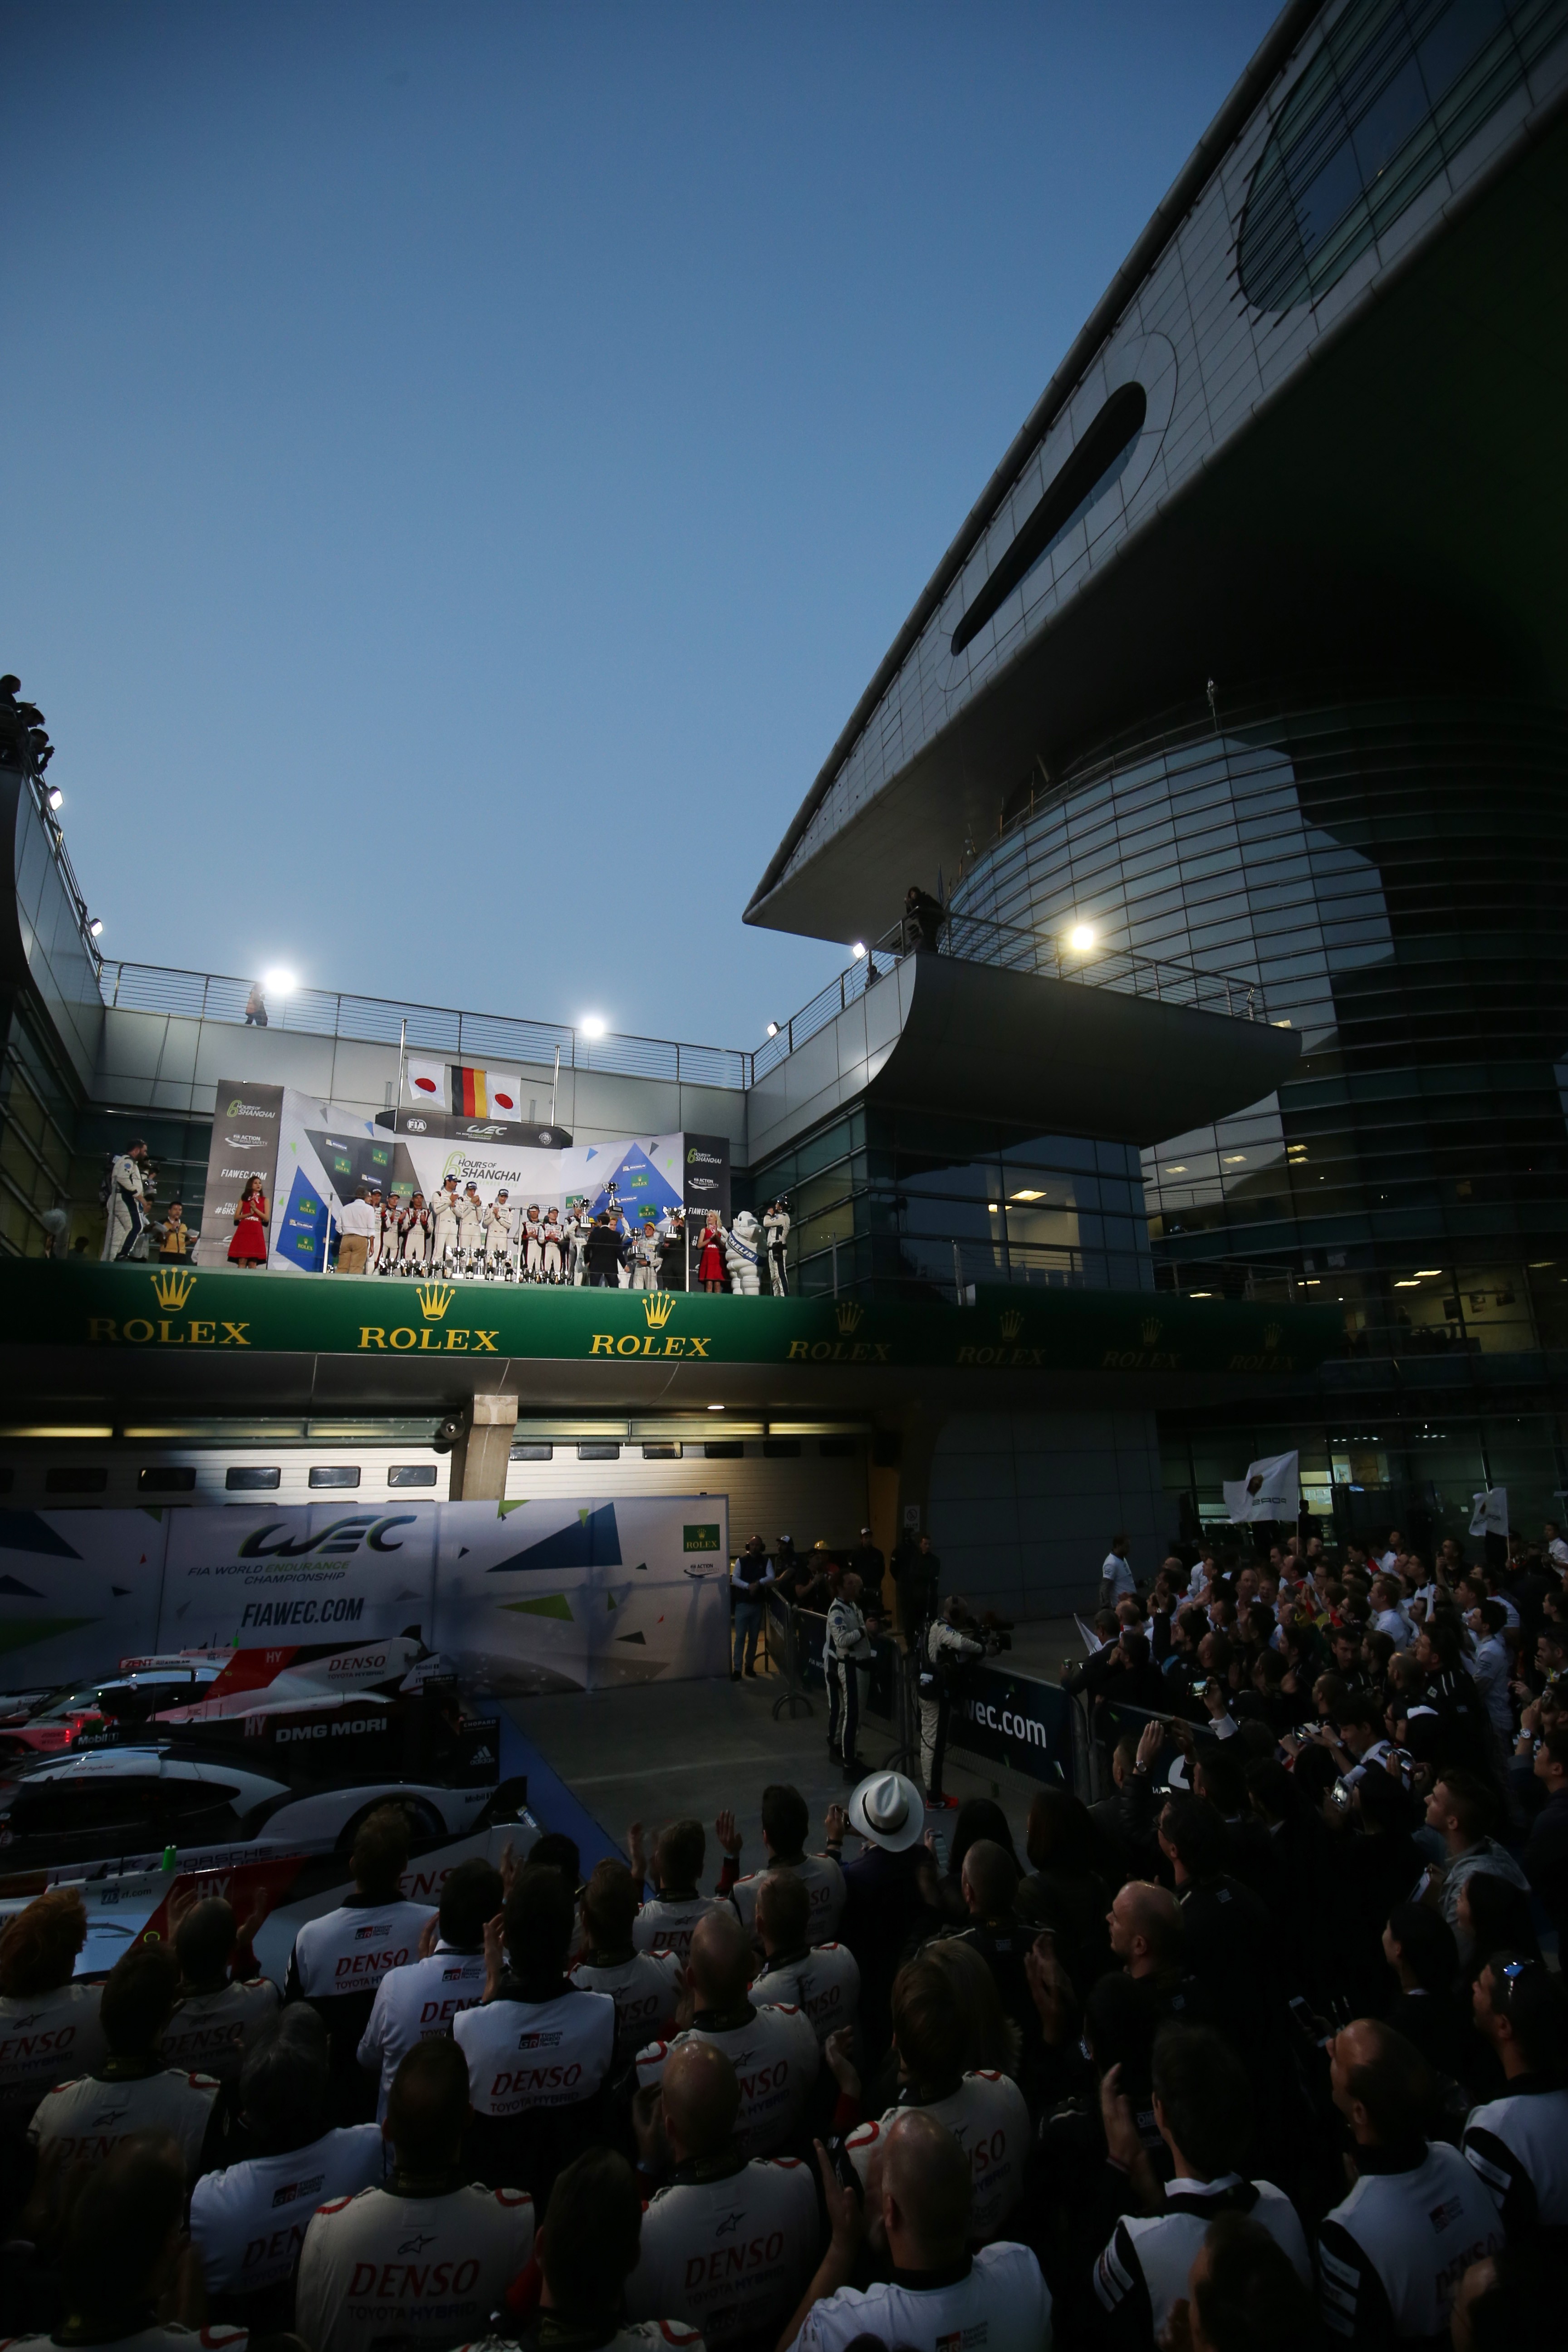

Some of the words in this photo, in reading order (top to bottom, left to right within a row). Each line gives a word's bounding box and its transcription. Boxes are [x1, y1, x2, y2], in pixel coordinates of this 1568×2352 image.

[227, 1100, 242, 1117] 6
[238, 1109, 275, 1118] SHANGHAI
[466, 1125, 507, 1136] WEC
[373, 1156, 387, 1164] ROLEX
[458, 1158, 487, 1169] HOURS
[687, 1148, 697, 1163] 6
[335, 1165, 349, 1173] ROLEX
[461, 1168, 521, 1182] SHANGHAI
[88, 1318, 251, 1345] ROLEX
[358, 1328, 499, 1351] ROLEX
[589, 1335, 711, 1356] ROLEX
[787, 1341, 892, 1361] ROLEX
[956, 1347, 1046, 1365] ROLEX
[1101, 1352, 1181, 1370] ROLEX
[1227, 1355, 1296, 1371] ROLEX
[238, 1515, 417, 1558] WEC
[686, 1540, 717, 1548] ROLEX
[188, 1568, 210, 1576] FIA
[216, 1565, 263, 1575] WORLD
[265, 1561, 351, 1572] ENDURANCE
[244, 1573, 345, 1585] CHAMPIONSHIP
[241, 1598, 364, 1627] FIAWEC.COM
[125, 1659, 153, 1668] ZENT
[265, 1651, 282, 1663] HY
[328, 1656, 386, 1671] DENSO
[244, 1716, 267, 1737] HY
[275, 1725, 328, 1743] DMG
[331, 1717, 387, 1736] MORI
[463, 1720, 496, 1728] CHOPARD
[78, 1735, 108, 1745] Mobil
[470, 1757, 495, 1766] adidas
[465, 1794, 485, 1803] Mobil
[176, 1847, 273, 1867] PORSCHE
[121, 1888, 152, 1899] zf.com
[196, 1877, 231, 1901] HY
[652, 1931, 694, 1947] DEN
[335, 1949, 408, 1976] DENSO
[335, 1978, 369, 1990] TOYOTA
[616, 1995, 658, 2021] NSO
[807, 1985, 840, 2018] NSO
[0, 2027, 75, 2061] ENSO
[521, 2038, 539, 2048] GR
[22, 2050, 73, 2069] HYBRID
[491, 2063, 581, 2096] DENSO
[739, 2060, 788, 2100] NSO
[491, 2098, 531, 2112] TOYOTA
[534, 2092, 579, 2105] HYBRID
[748, 2088, 789, 2116] HYBRID
[274, 2192, 295, 2205] GR
[242, 2221, 309, 2269] DEN
[685, 2232, 784, 2290] DENSO
[348, 2259, 480, 2298] DENSO
[686, 2284, 734, 2308] TOYOTA
[735, 2264, 785, 2294] HYBRID
[348, 2305, 406, 2320] TOYOTA
[410, 2301, 478, 2320] HYBRID
